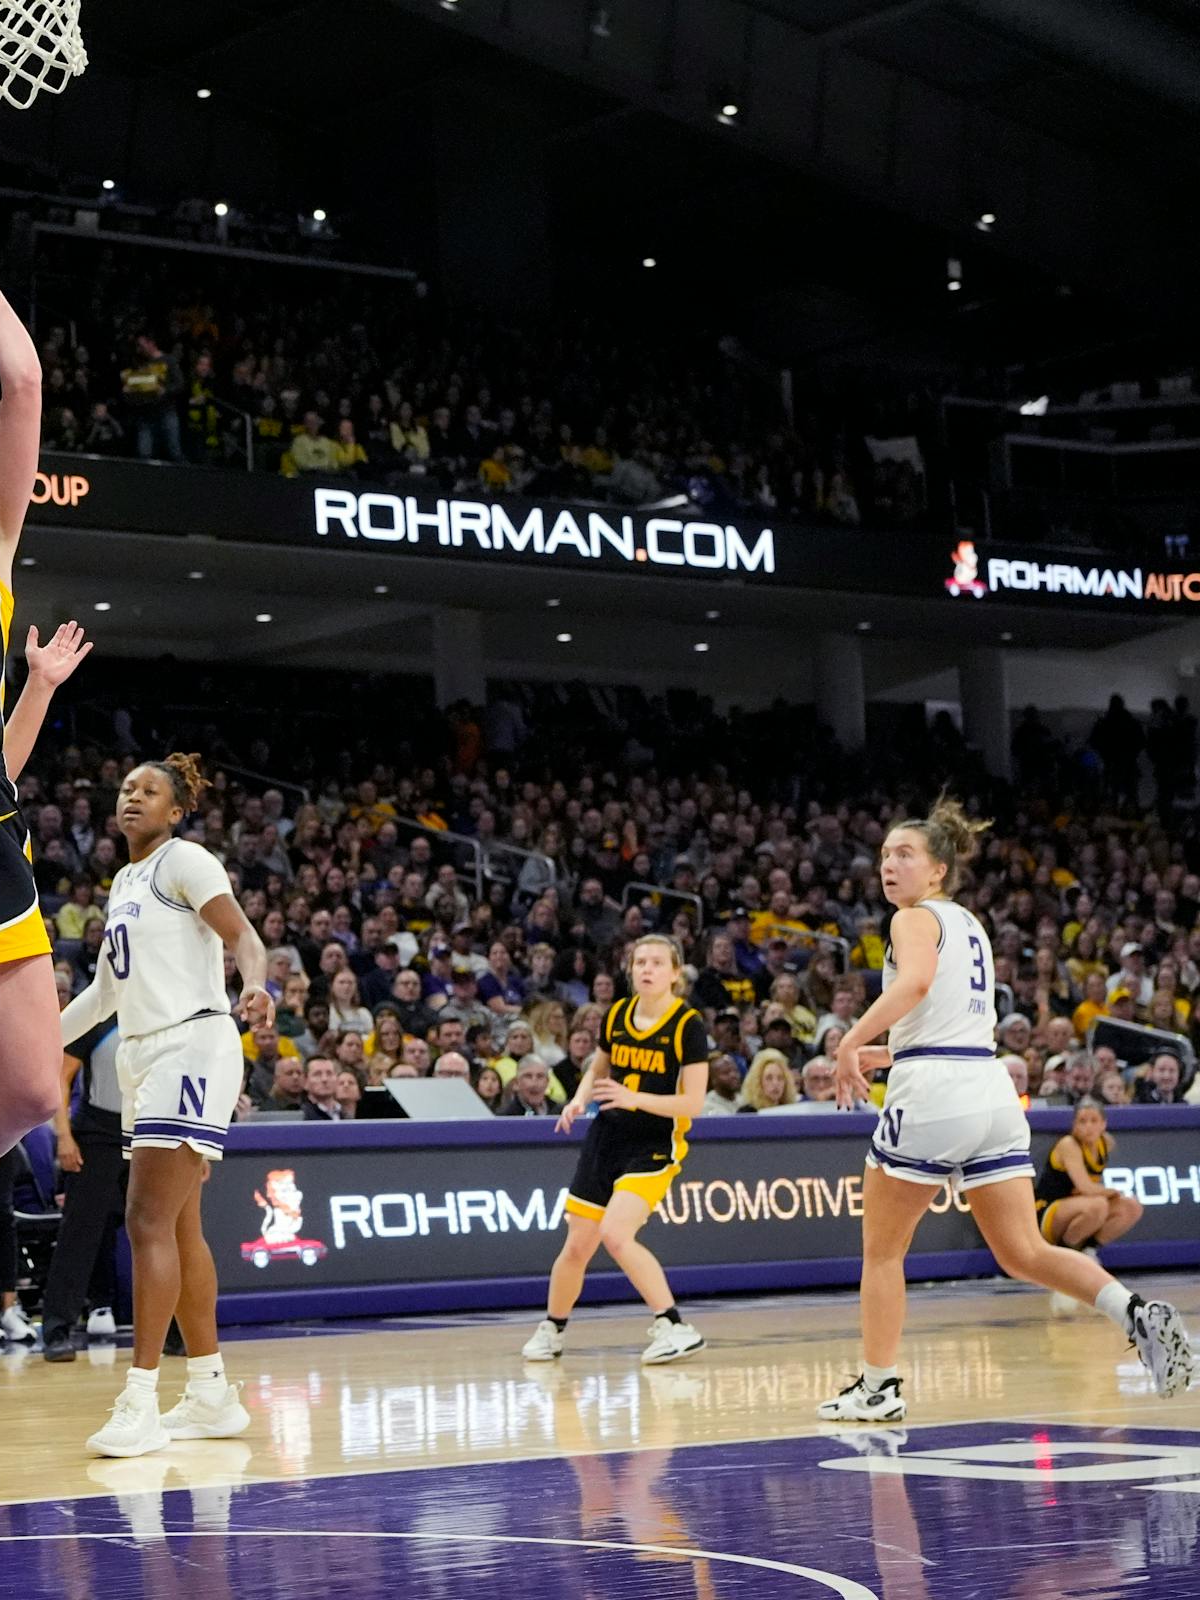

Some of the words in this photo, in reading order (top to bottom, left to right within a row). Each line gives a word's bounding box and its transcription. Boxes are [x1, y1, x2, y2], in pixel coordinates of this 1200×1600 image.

[31, 472, 90, 507] OUP
[314, 487, 776, 573] ROHRMAN.COM
[988, 557, 1143, 599] ROHRMAN
[968, 934, 987, 992] 3
[611, 1043, 667, 1074] IOWA
[178, 1075, 207, 1118] N
[880, 1105, 904, 1148] N
[330, 1187, 569, 1250] ROHRM
